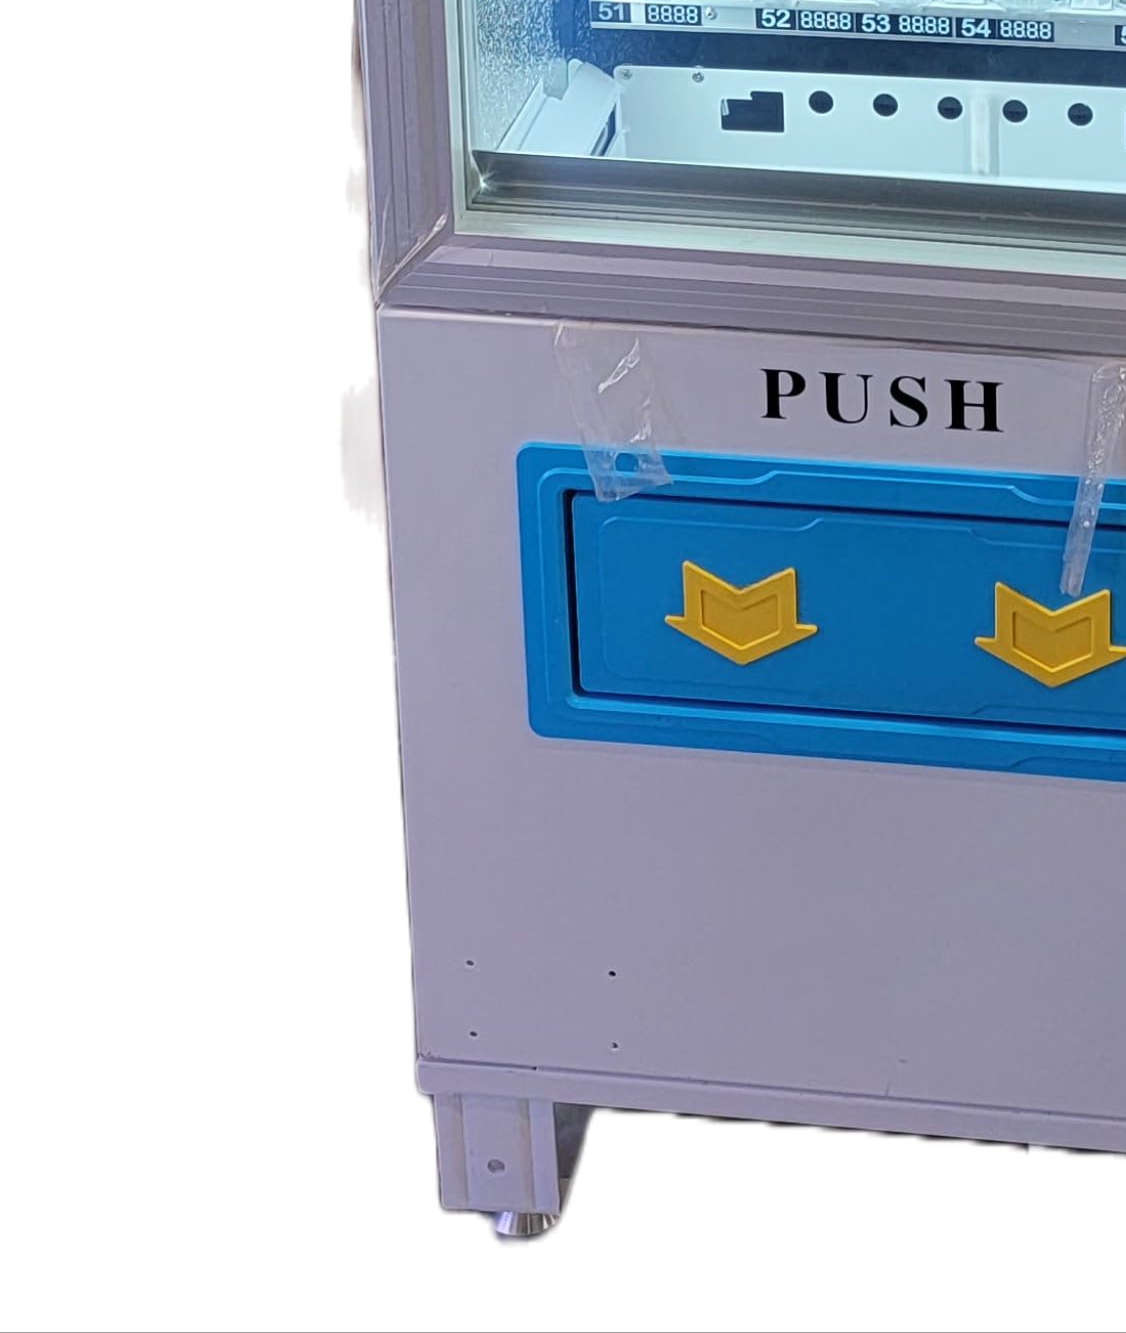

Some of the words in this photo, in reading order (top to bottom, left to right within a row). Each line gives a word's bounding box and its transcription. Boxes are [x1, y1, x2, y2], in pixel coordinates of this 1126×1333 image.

[599, 3, 625, 20] 51
[761, 10, 791, 28] 52
[861, 14, 890, 32] 53
[961, 18, 991, 37] 54
[759, 367, 1005, 433] PUSH
